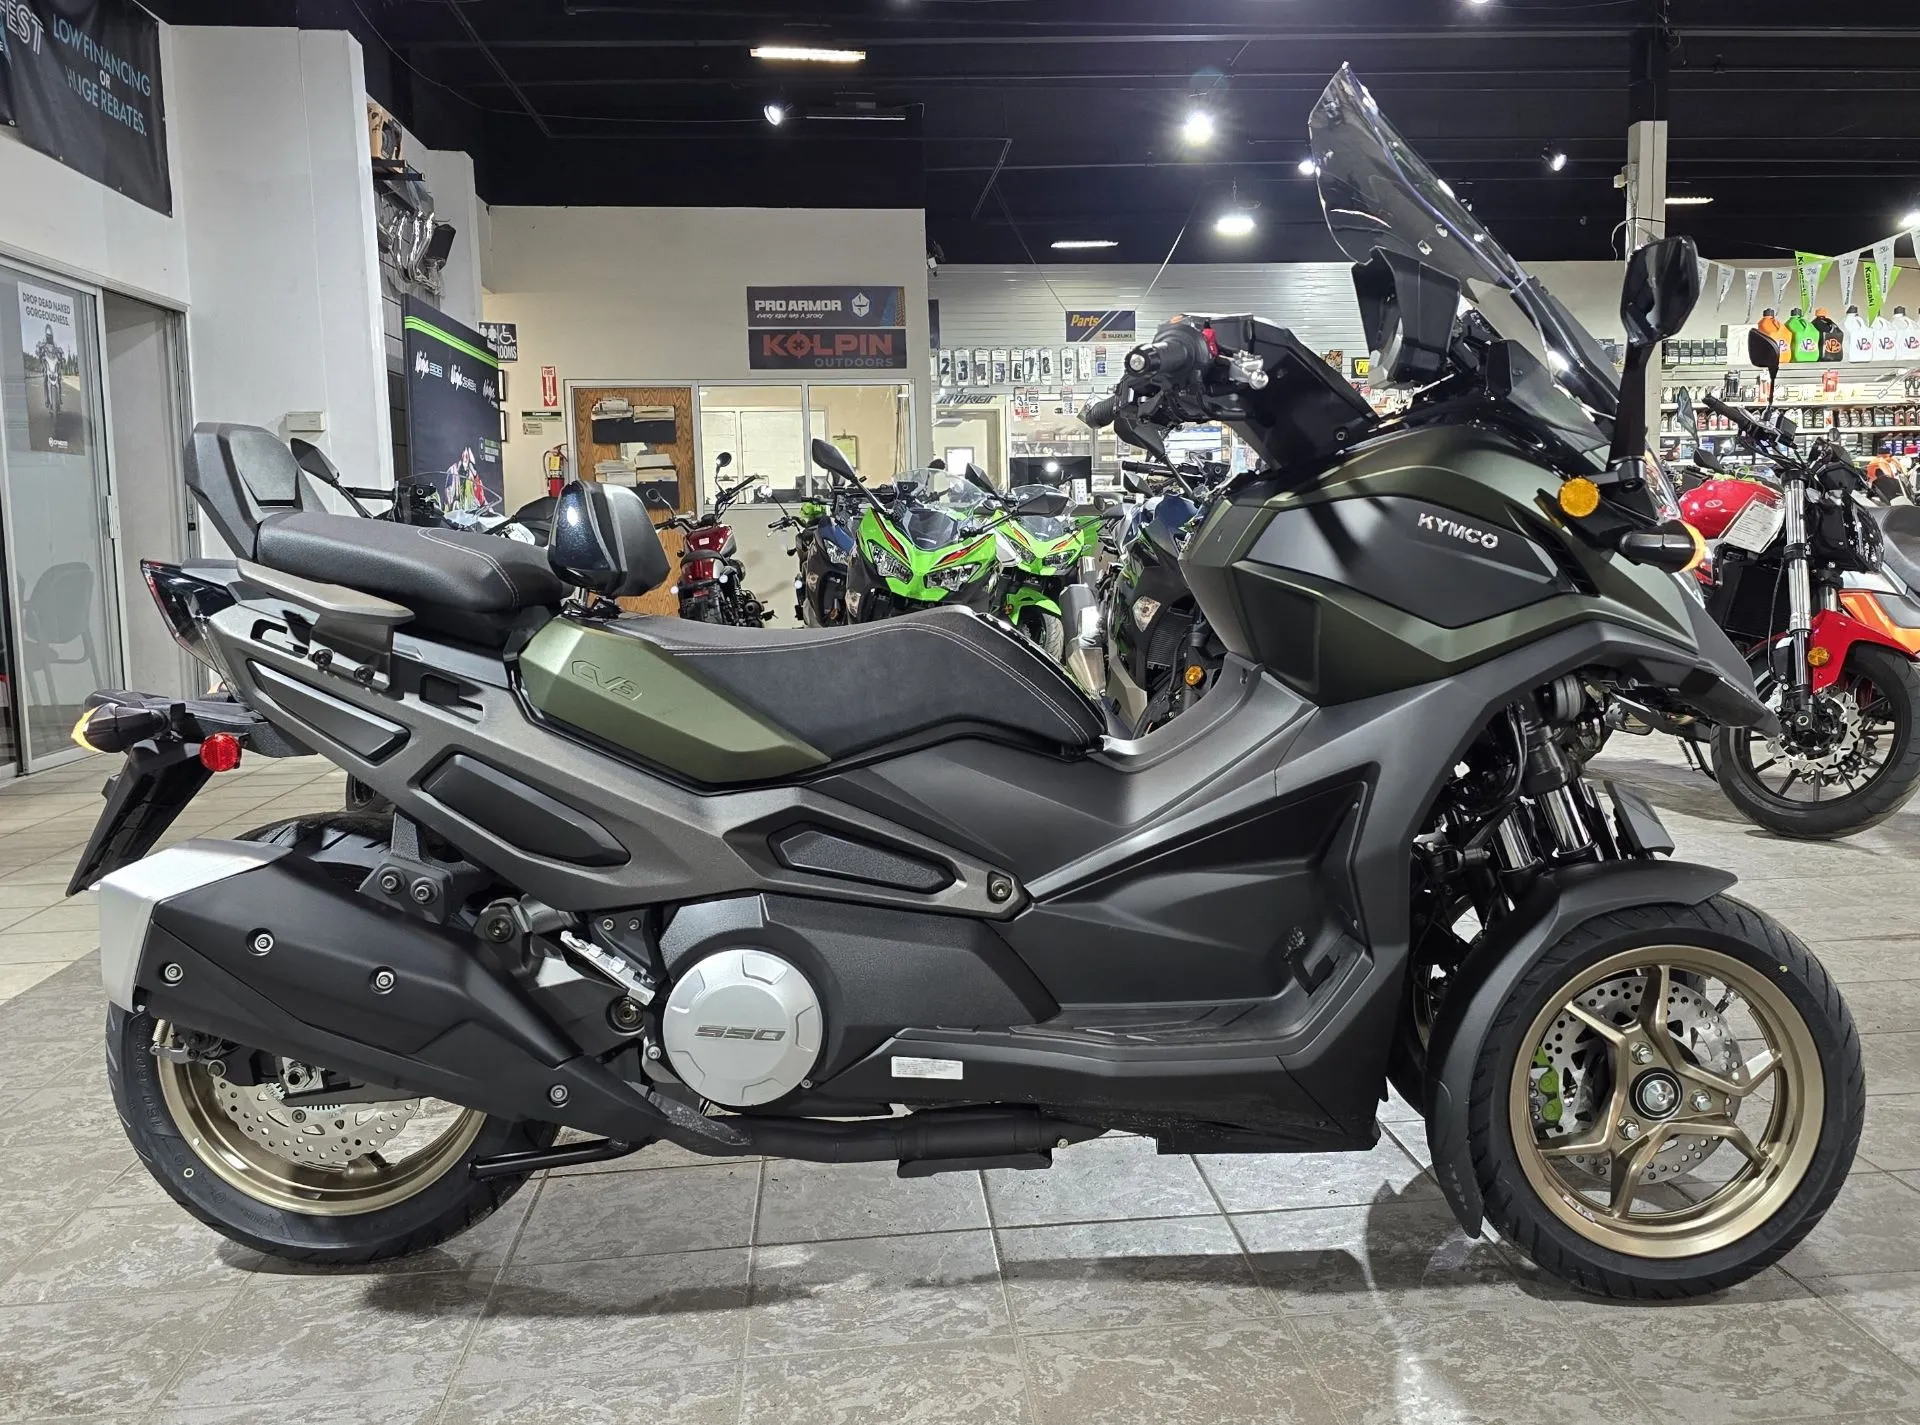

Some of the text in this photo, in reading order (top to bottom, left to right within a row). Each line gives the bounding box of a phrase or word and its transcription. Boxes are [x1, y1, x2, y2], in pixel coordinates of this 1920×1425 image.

[53, 14, 150, 97] LOW FINANCING
[65, 65, 98, 107] HUGE
[100, 70, 110, 90] OR
[1864, 266, 1875, 307] Kawasaki
[22, 292, 38, 305] DROP
[754, 299, 842, 312] PRO ARMOR
[1070, 314, 1100, 327] Parts
[763, 332, 893, 358] KOLPIN
[814, 358, 893, 367] OUTDOORS
[1417, 512, 1499, 549] KYMCO
[695, 1025, 787, 1041] 550
